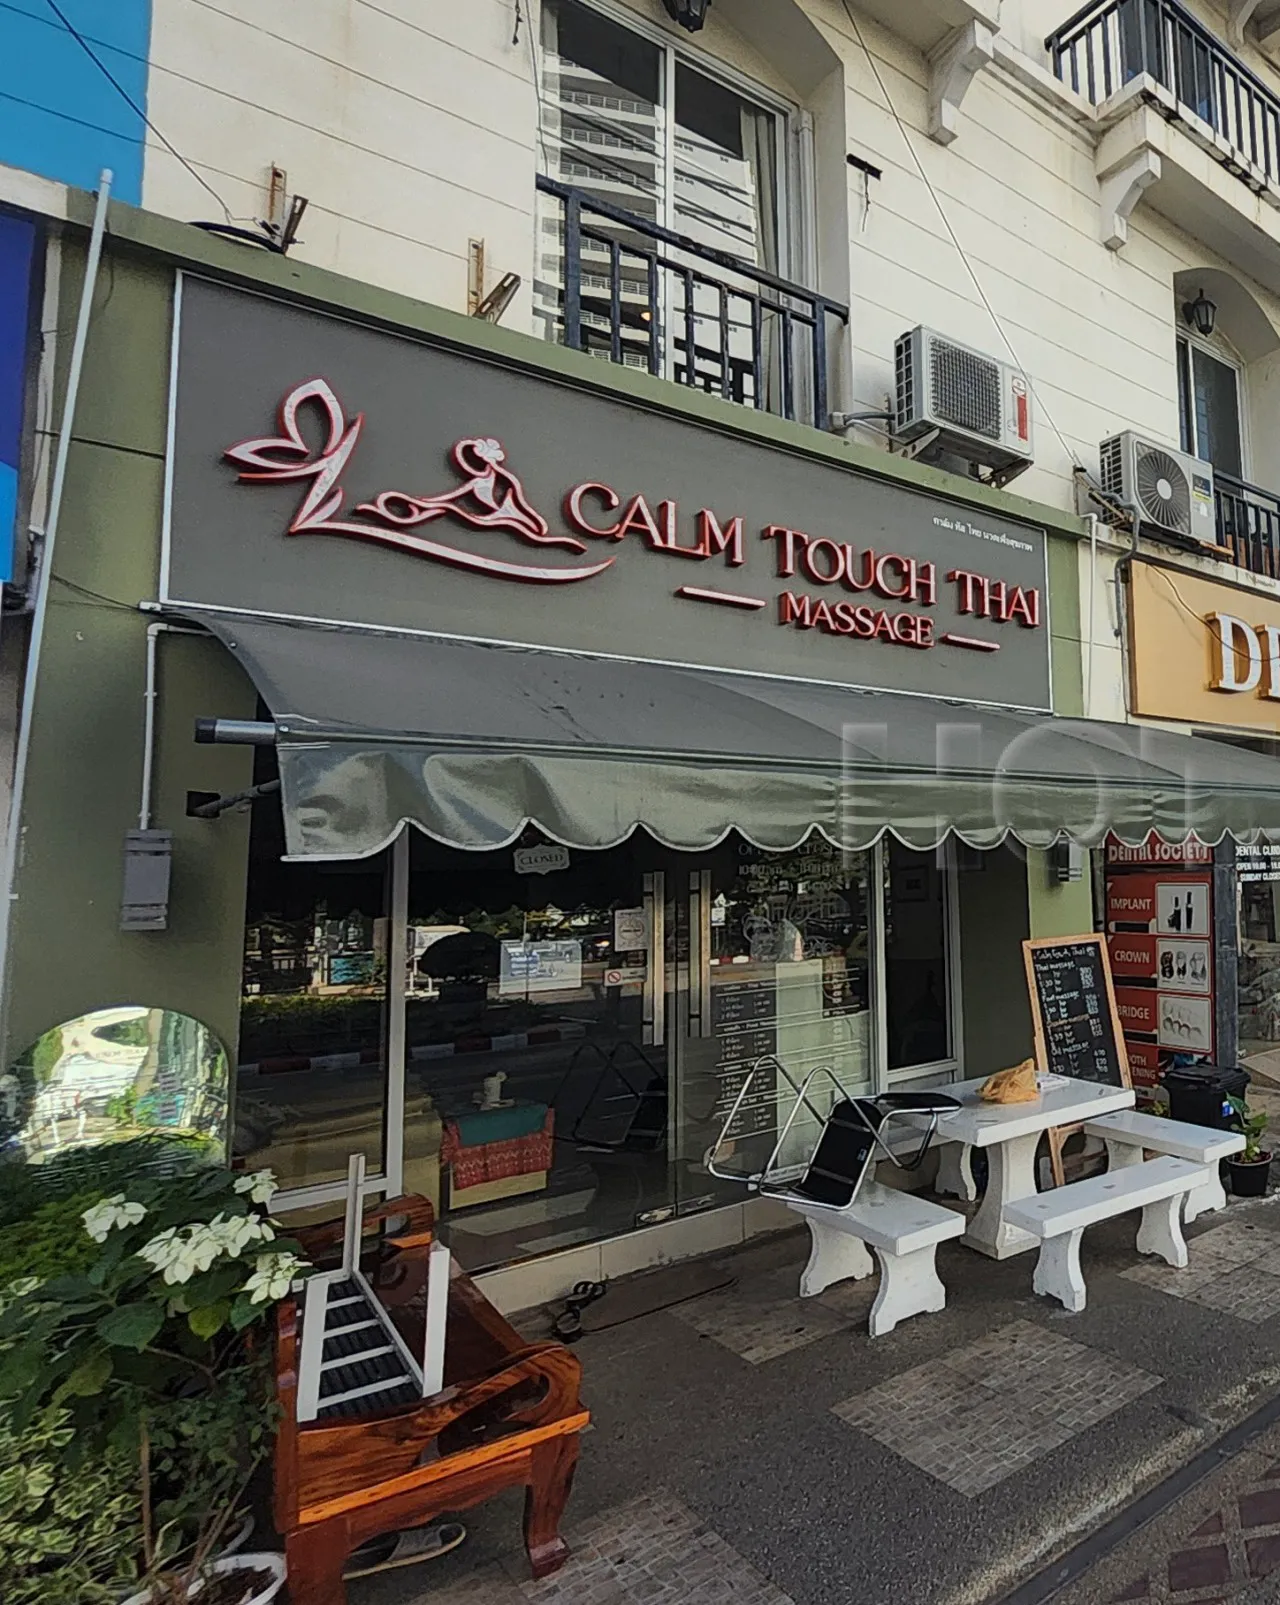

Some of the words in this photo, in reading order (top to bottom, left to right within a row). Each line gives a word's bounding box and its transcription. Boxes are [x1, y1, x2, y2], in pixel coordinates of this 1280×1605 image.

[562, 481, 746, 566] CALM
[762, 525, 937, 606] TOUCH
[946, 569, 1041, 628] THAI
[778, 591, 936, 649] MASSAGE
[1108, 844, 1152, 862] DENTAL
[1235, 844, 1262, 857] DENTAL
[1110, 898, 1152, 911] IMPLANT
[1114, 949, 1150, 964] CROWN
